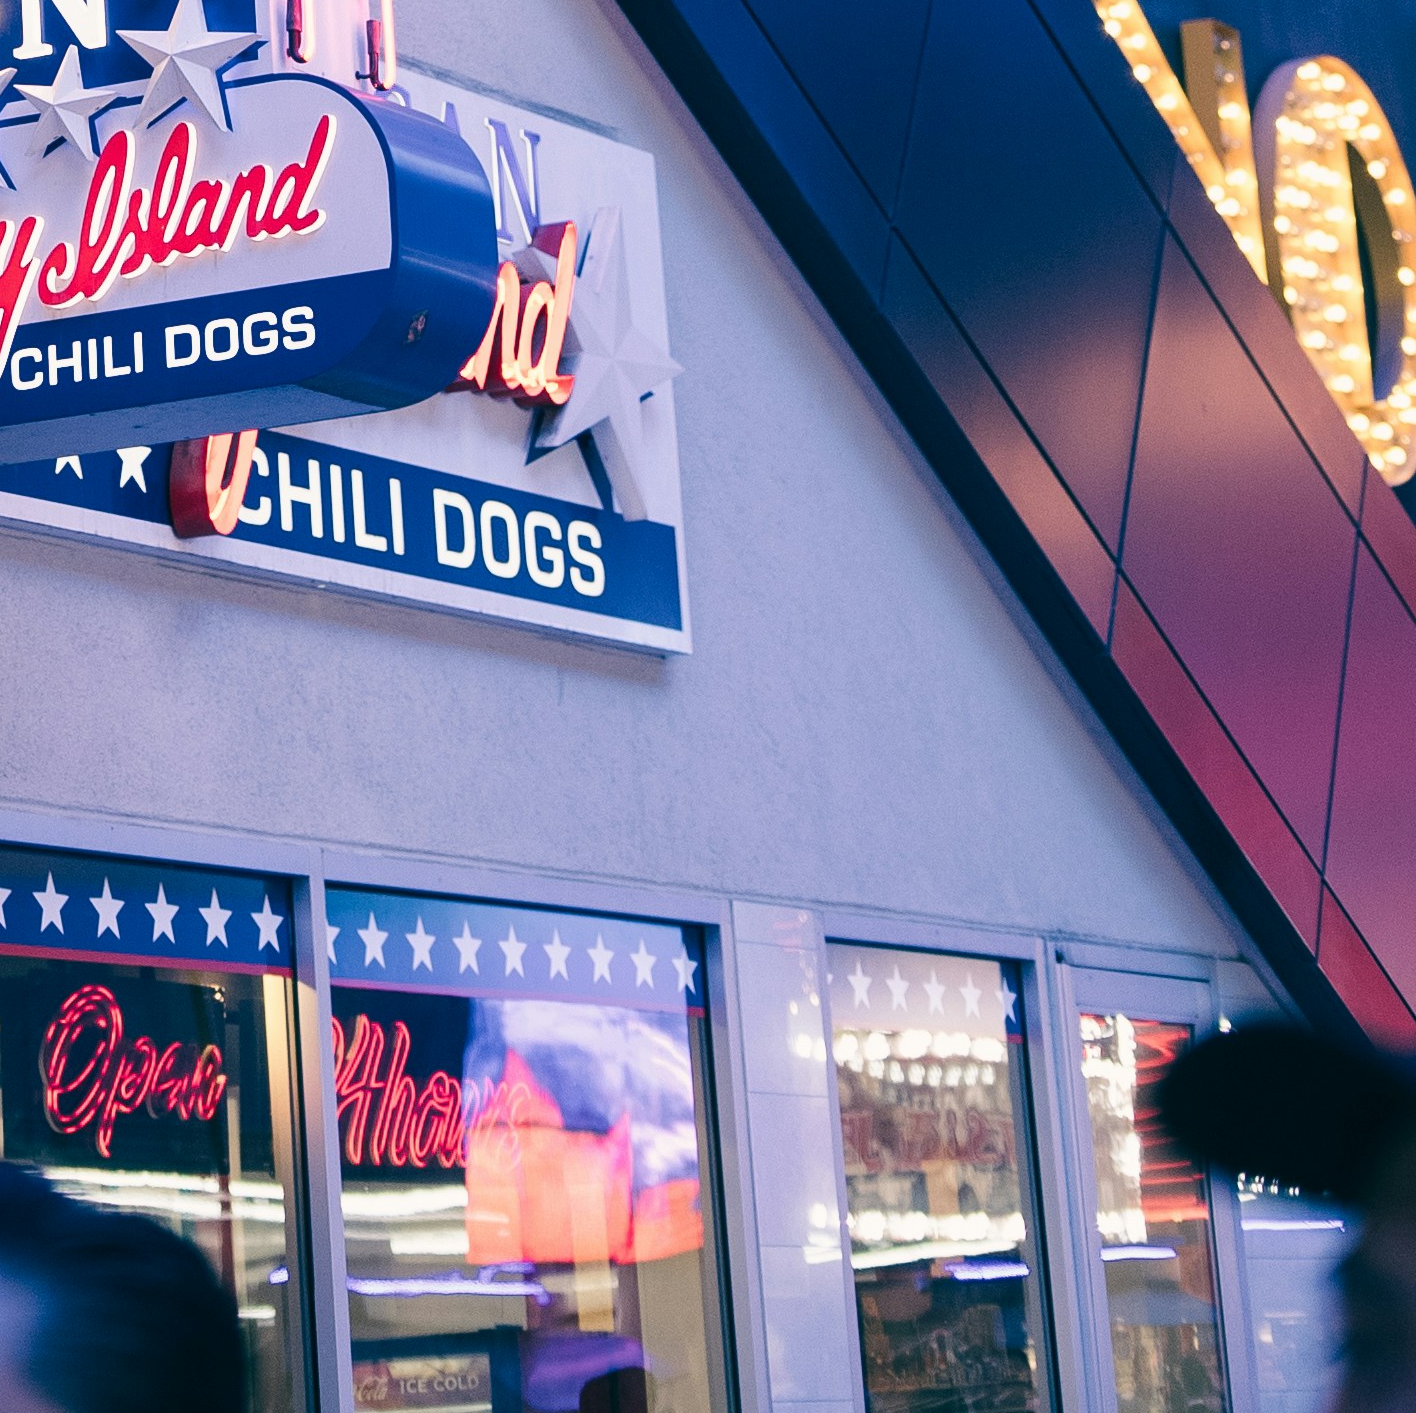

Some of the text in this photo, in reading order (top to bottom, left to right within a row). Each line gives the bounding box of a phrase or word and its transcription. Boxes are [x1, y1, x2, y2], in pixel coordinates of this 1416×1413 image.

[36, 115, 339, 309] Island
[10, 304, 317, 393] CHILI DOGS
[434, 485, 608, 600] DOGS
[40, 984, 227, 1158] Open
[399, 1379, 428, 1395] ICE
[433, 1375, 480, 1393] COLD
